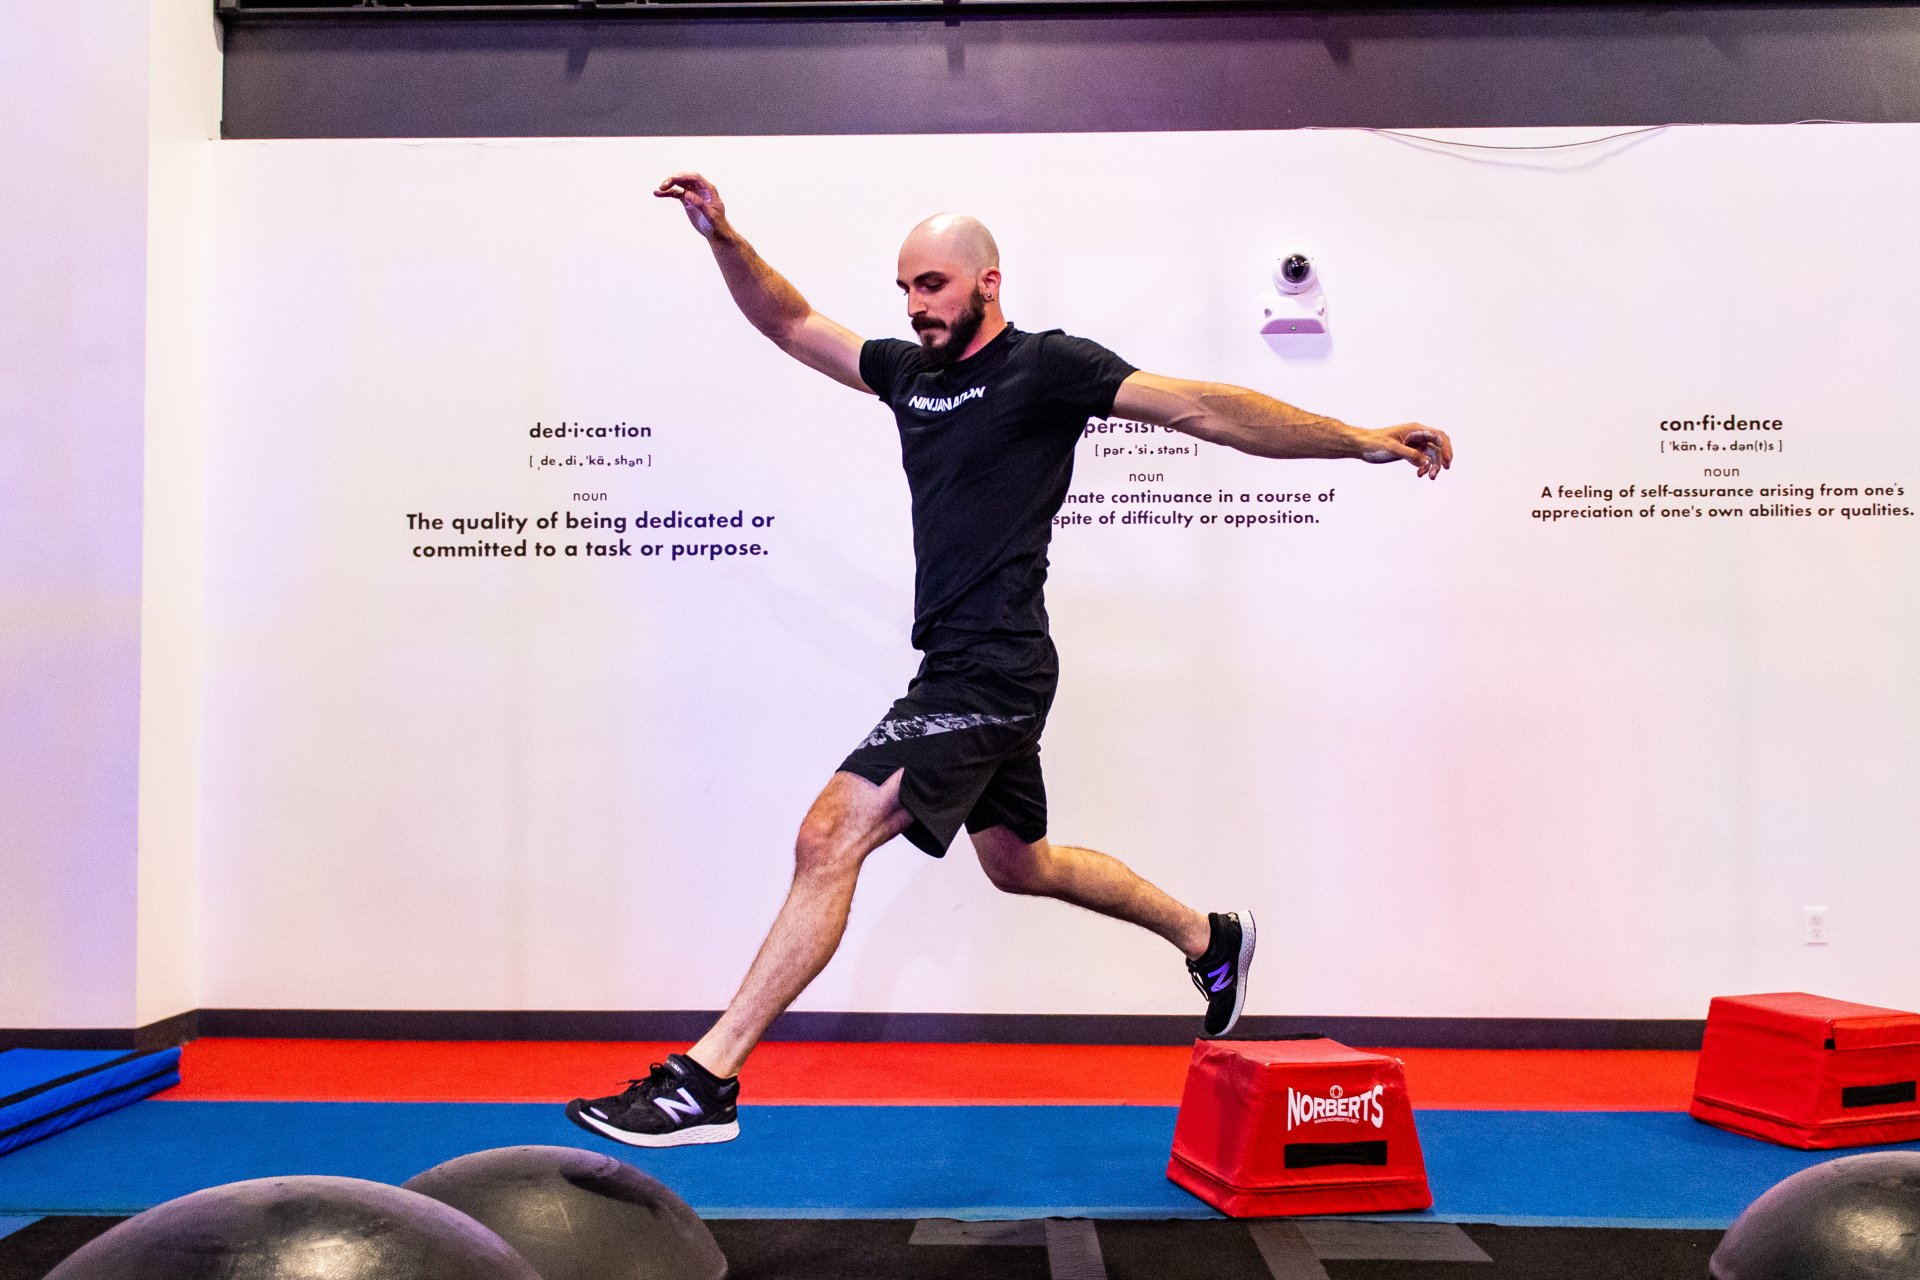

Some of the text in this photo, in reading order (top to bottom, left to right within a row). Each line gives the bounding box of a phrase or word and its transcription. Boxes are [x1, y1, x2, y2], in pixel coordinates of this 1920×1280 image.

[1128, 473, 1164, 483] noun
[1703, 468, 1740, 477] noun
[573, 492, 608, 502] noun
[1111, 490, 1213, 503] continuance
[1219, 489, 1234, 503] in
[1240, 493, 1251, 503] a
[1257, 493, 1312, 503] course
[1318, 488, 1336, 502] of
[1541, 482, 1905, 501] A feeling of self-assurance arising from one's
[1099, 510, 1116, 525] of
[1122, 510, 1194, 528] difficulty
[1200, 514, 1219, 525] or
[1224, 510, 1320, 528] opposition.
[1531, 503, 1915, 522] appreciation of one's own abilities or qualities.
[406, 510, 776, 534] The quality of being dedicated or
[412, 538, 769, 561] committed to a task or purpose.
[1287, 1084, 1384, 1132] NORBERTS
